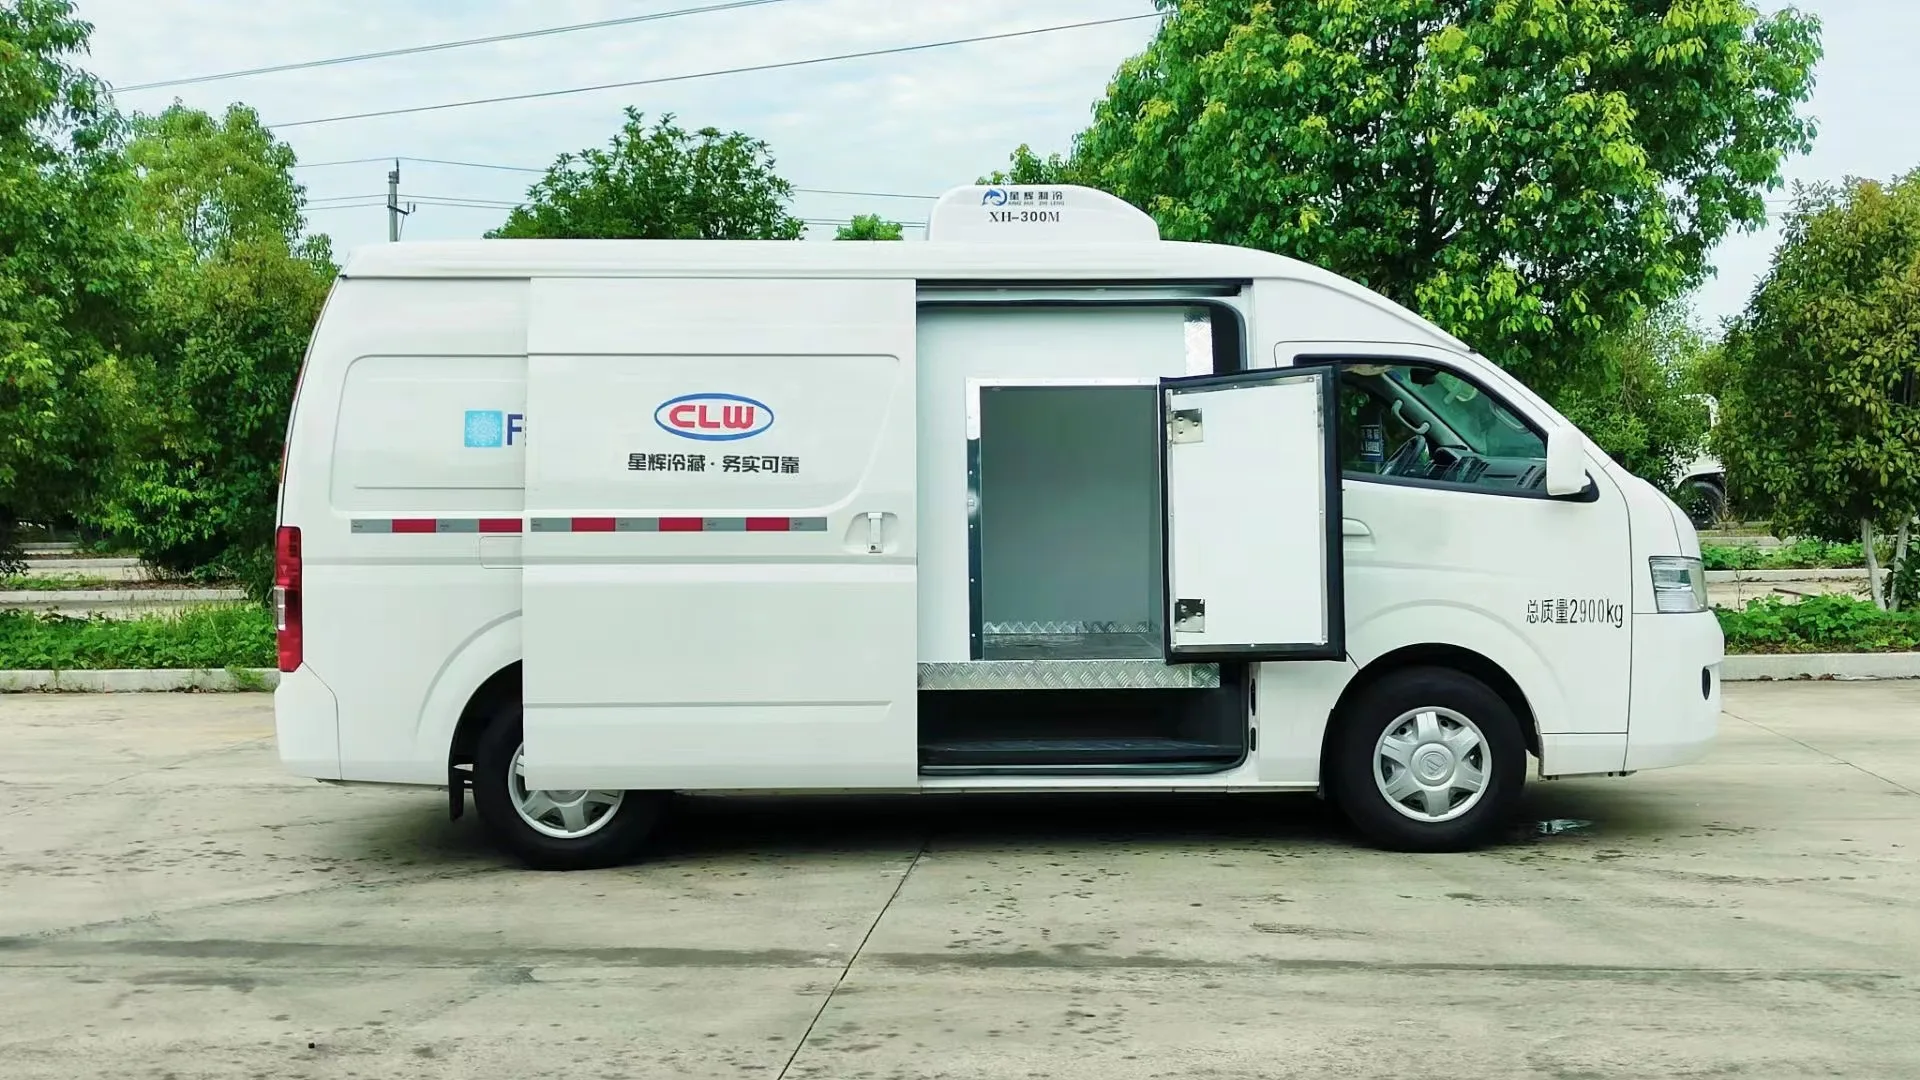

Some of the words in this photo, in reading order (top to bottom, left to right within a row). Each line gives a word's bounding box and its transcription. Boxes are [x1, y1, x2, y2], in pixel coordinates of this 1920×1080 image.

[989, 211, 1060, 222] XH-300M
[668, 404, 755, 429] CLW
[1526, 598, 1624, 628] 总质量2900kg
